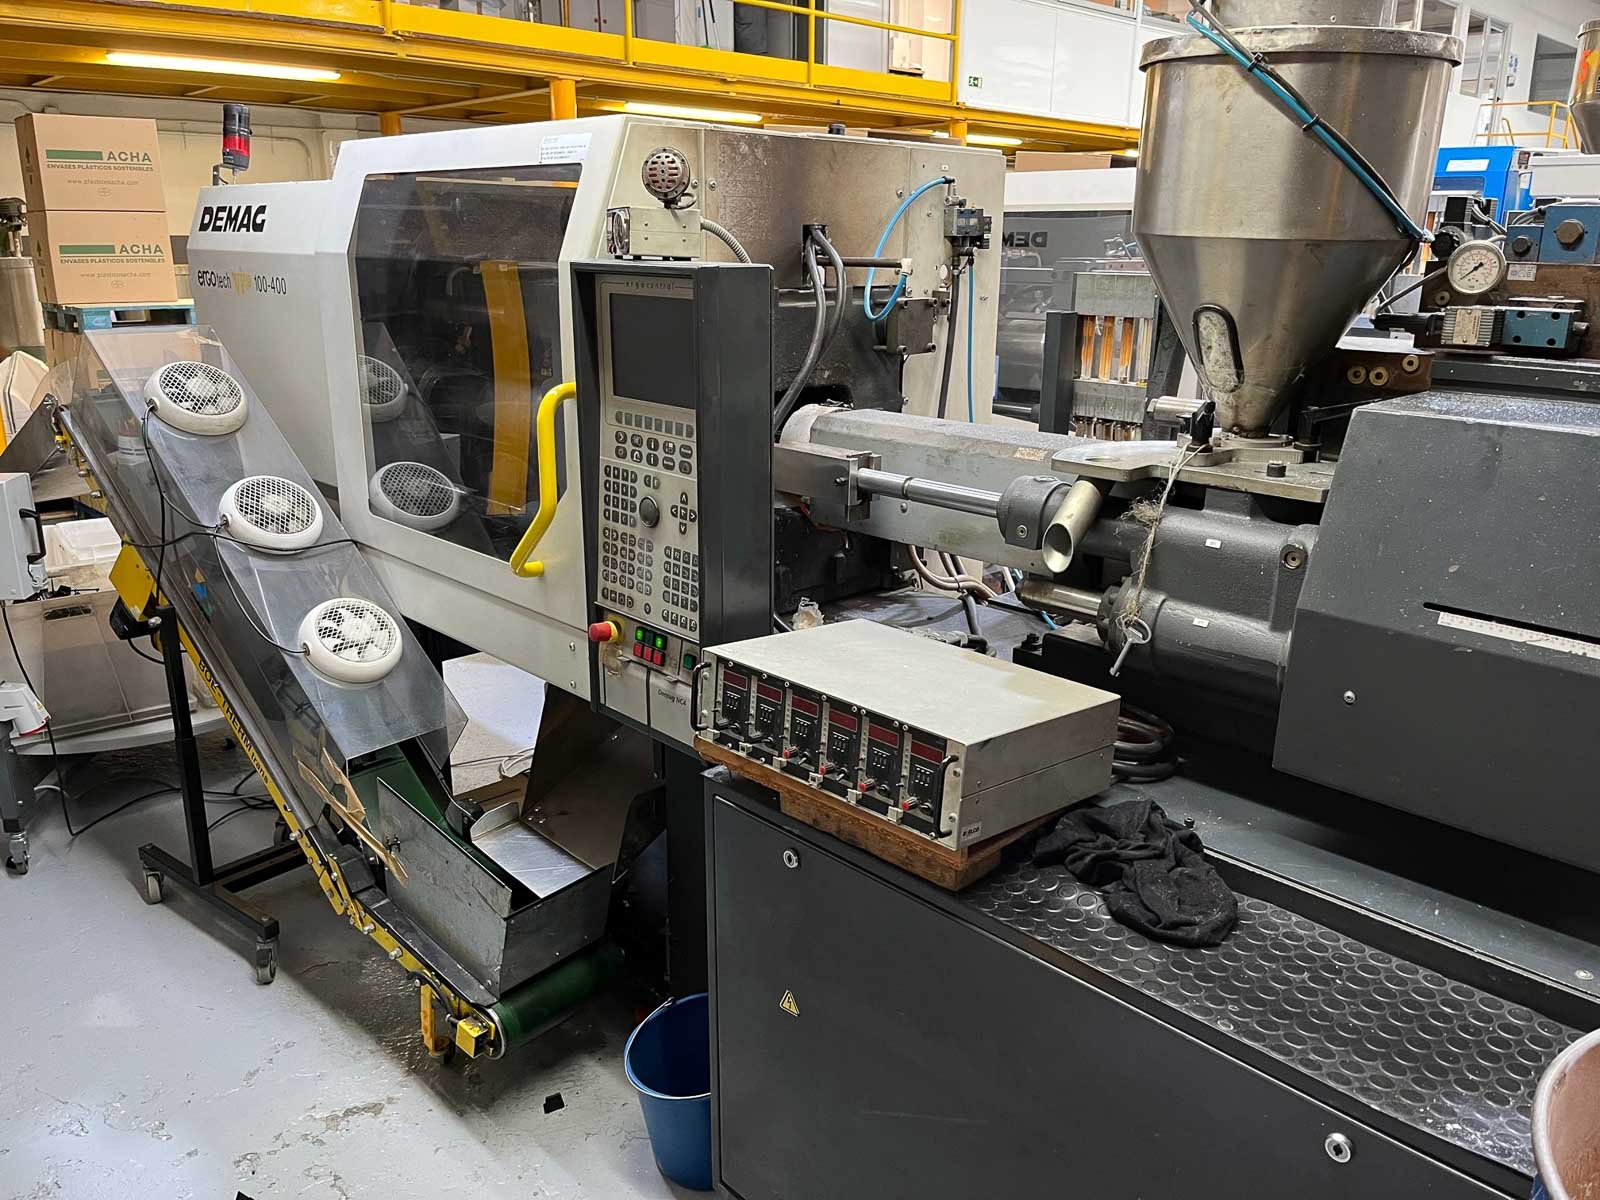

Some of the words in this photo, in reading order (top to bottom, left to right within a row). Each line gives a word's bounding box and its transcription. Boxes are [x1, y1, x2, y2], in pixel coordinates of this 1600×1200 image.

[107, 151, 152, 163] ACHA
[77, 163, 112, 171] PLÁSTICOS
[198, 205, 267, 232] DEMAG
[119, 244, 164, 255] ACHA
[254, 275, 287, 295] 100-400
[250, 753, 269, 784] trans
